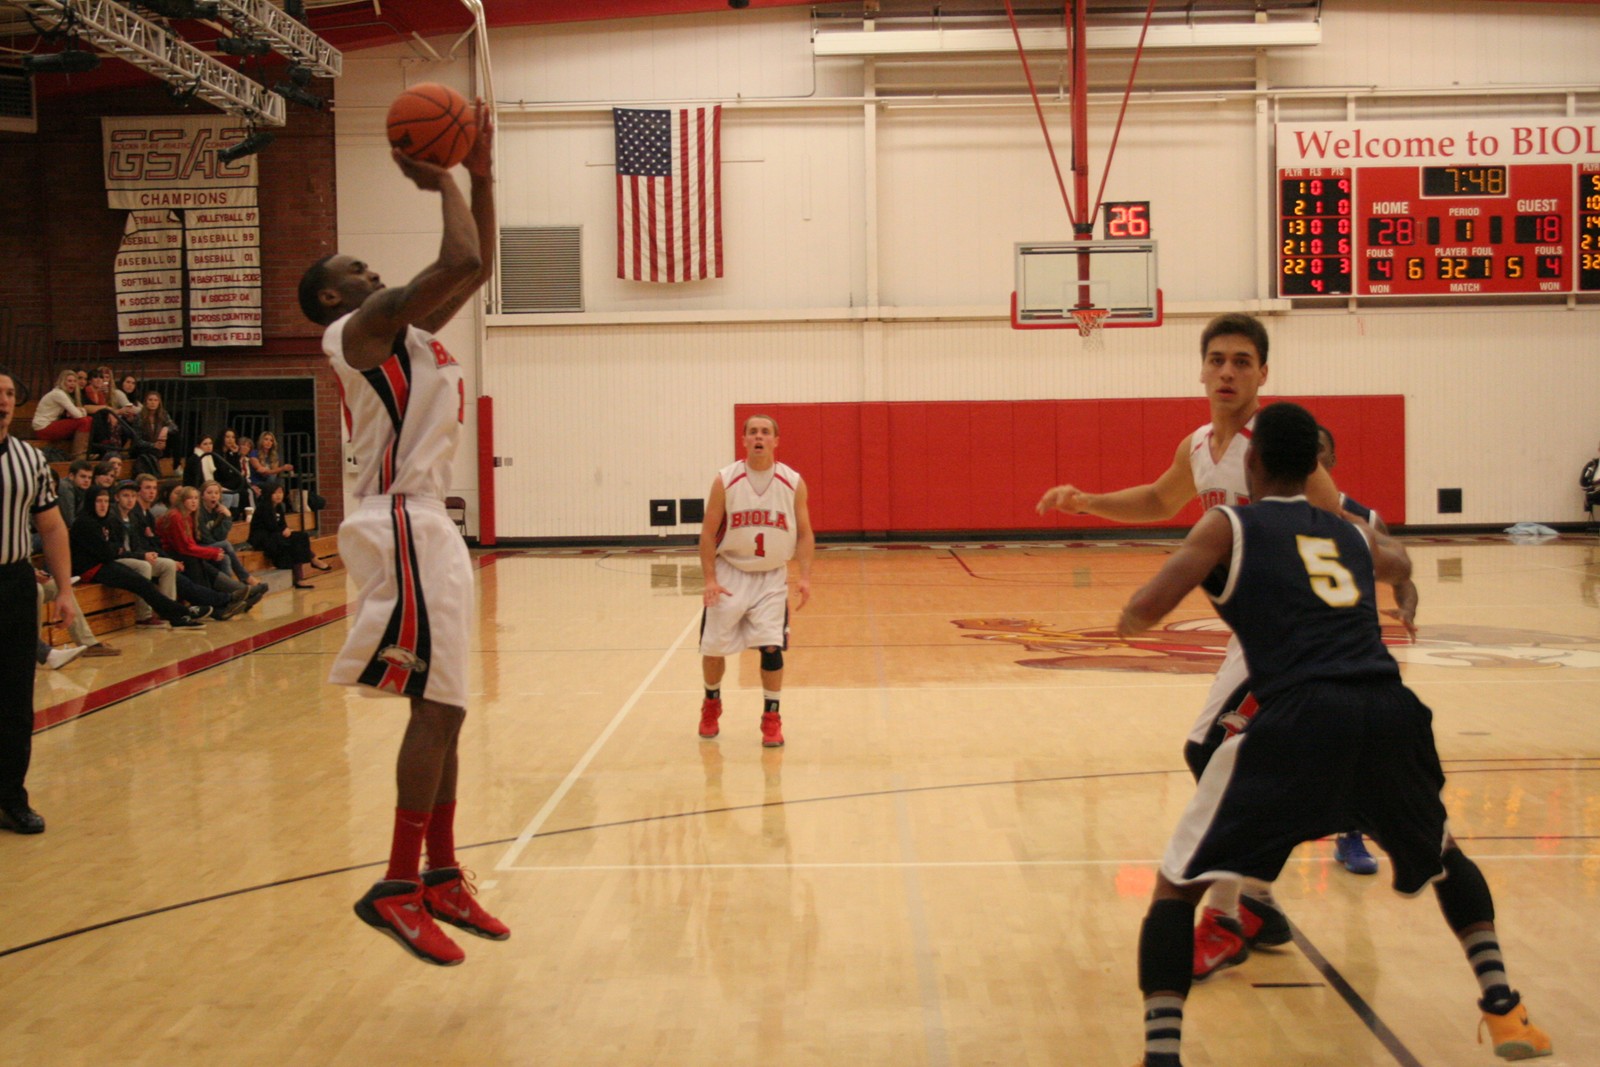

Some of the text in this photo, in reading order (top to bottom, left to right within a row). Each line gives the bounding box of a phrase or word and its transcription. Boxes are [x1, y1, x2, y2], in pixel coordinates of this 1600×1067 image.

[1293, 128, 1455, 159] Welcome
[1466, 130, 1499, 157] to
[1330, 167, 1344, 176] PTS
[1444, 168, 1503, 194] 7:48
[1310, 179, 1323, 196] 0
[1337, 179, 1350, 194] 9
[140, 192, 227, 206] CHAMPIONS
[1294, 199, 1306, 216] 2
[1337, 198, 1350, 215] 0
[1372, 201, 1409, 215] HOME
[1516, 199, 1558, 213] GUEST
[1449, 207, 1480, 217] PERIOD
[196, 213, 243, 223] VOLLEYBALL
[1109, 206, 1147, 236] 26
[1288, 218, 1350, 236] 13 0 0
[1378, 218, 1413, 245] 28
[1465, 220, 1472, 240] 1
[1535, 215, 1560, 243] 18
[122, 235, 159, 246] ASEBALL
[191, 233, 239, 244] BASEBALL
[1310, 238, 1323, 255] 0
[1337, 238, 1350, 255] 6
[1434, 247, 1494, 257] PLAYER FOUL
[1534, 246, 1563, 255] FOULS
[193, 253, 235, 264] BASEBALL
[1366, 248, 1394, 258] FOULS
[117, 255, 165, 267] BASEBALL
[1283, 258, 1350, 275] 22 0 3
[1377, 259, 1391, 278] 4
[1407, 258, 1423, 280] 6
[1507, 256, 1522, 278] 5
[1545, 257, 1560, 276] 4
[121, 277, 163, 287] SOFTBALL
[197, 274, 241, 284] BASKETBALL
[1369, 284, 1390, 293] WON
[1449, 283, 1480, 292] MATCH
[1539, 281, 1560, 291] WON
[129, 296, 160, 306] SOCCER
[209, 293, 237, 303] SOCCER
[128, 317, 166, 327] BASEBALL
[197, 313, 221, 322] CROSS
[222, 312, 253, 321] COUNTRY
[125, 337, 150, 347] CROSS
[199, 333, 222, 341] TRACK
[230, 332, 252, 341] FIELD
[185, 361, 201, 374] EXIT
[729, 508, 790, 533] BIOLA
[754, 532, 766, 558] 1
[1295, 534, 1361, 608] 5
